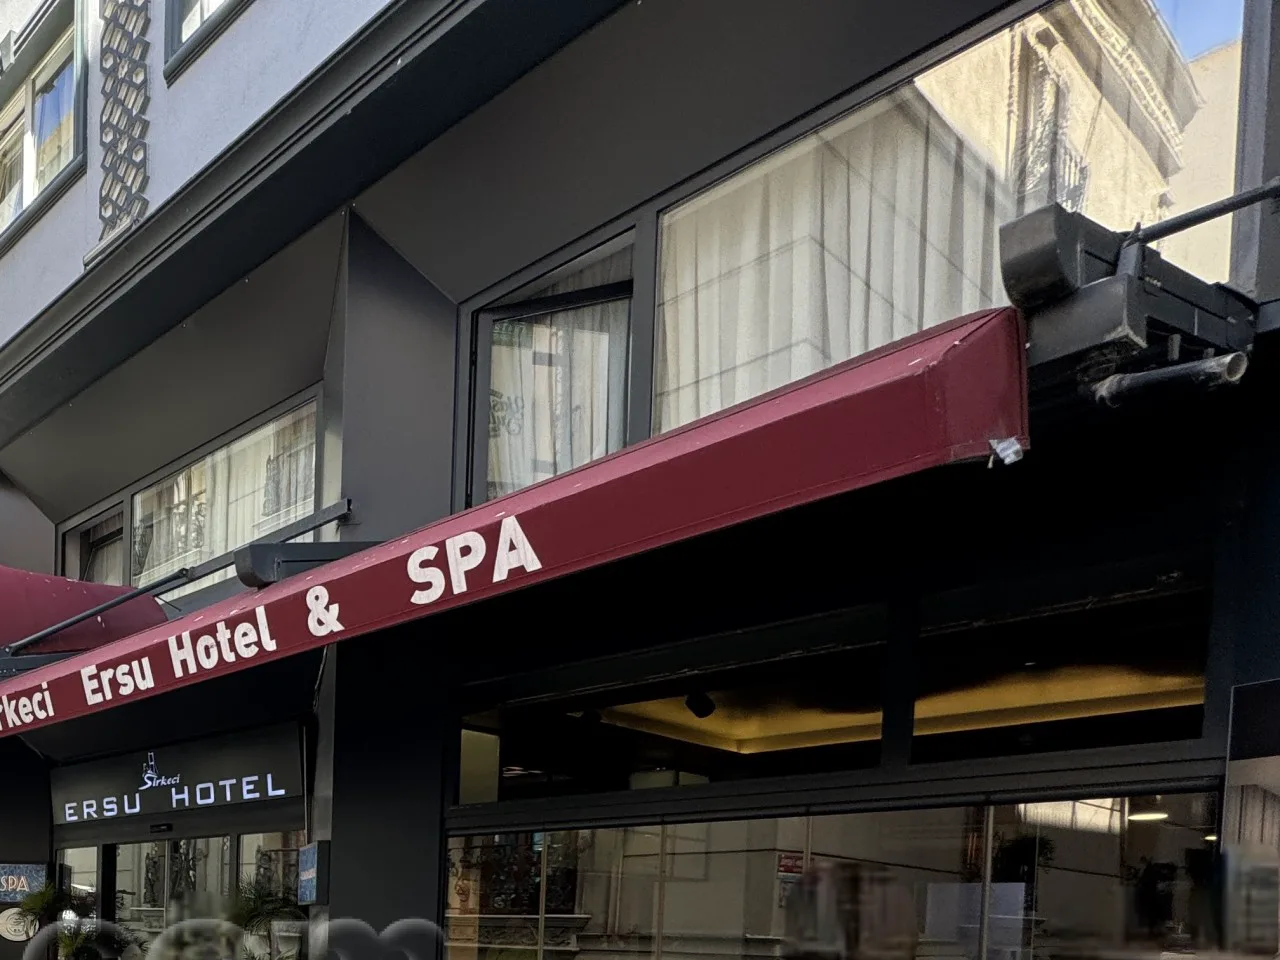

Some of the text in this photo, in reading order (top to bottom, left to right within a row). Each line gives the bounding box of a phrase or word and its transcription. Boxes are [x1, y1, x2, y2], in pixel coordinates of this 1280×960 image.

[81, 655, 155, 706] Ersu
[168, 606, 278, 679] Hotel
[305, 585, 346, 638] &
[407, 514, 543, 606] SPA
[64, 772, 286, 822] ERSU HOTEL
[138, 773, 181, 790] Sirkeci
[0, 875, 31, 892] SPA
